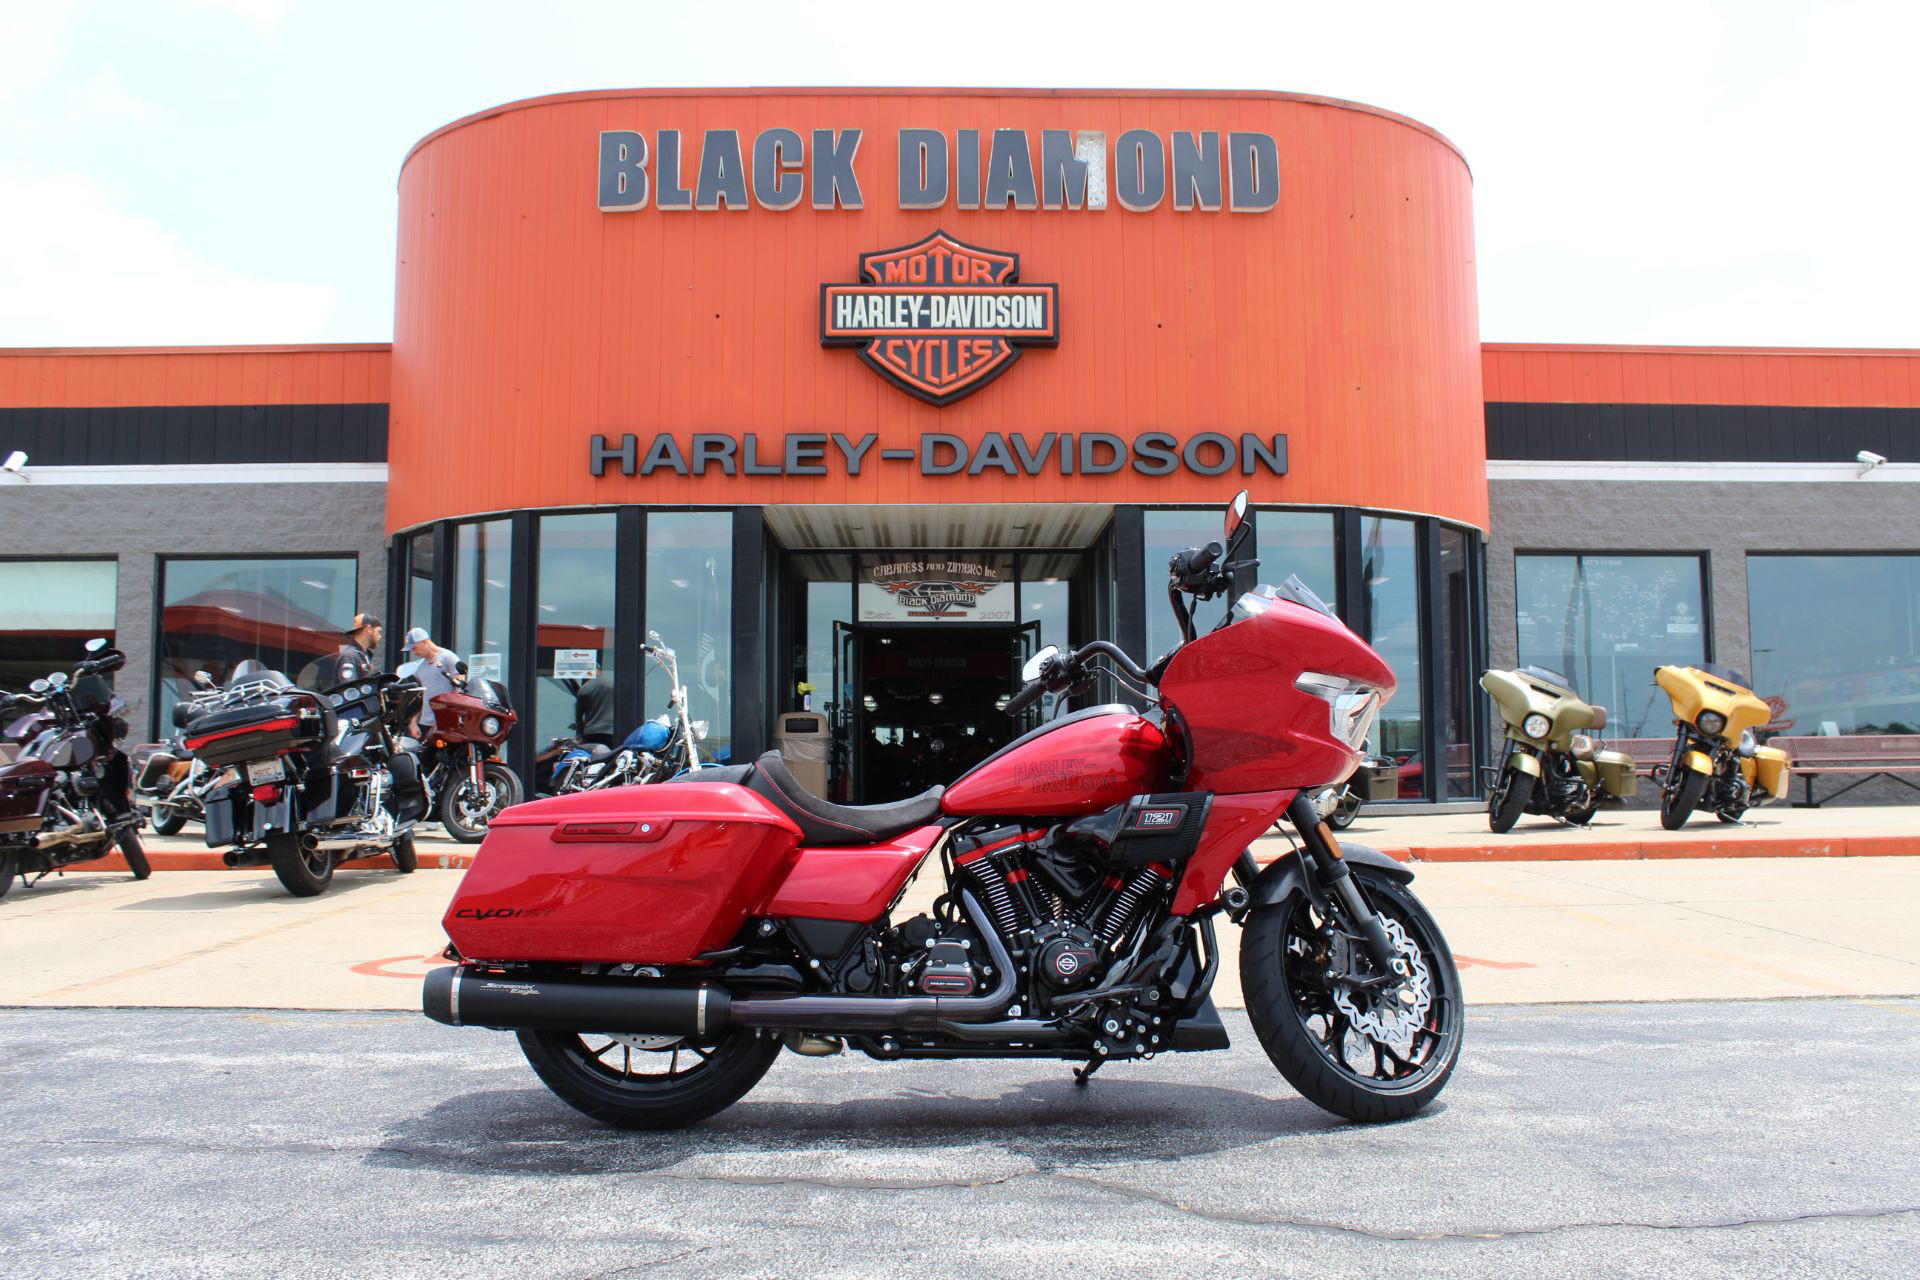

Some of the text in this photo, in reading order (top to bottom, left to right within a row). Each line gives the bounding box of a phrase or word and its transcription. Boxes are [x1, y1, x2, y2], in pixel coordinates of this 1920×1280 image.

[598, 128, 1280, 212] BLACK DIAMOND
[884, 246, 992, 285] MOTOR
[837, 294, 1043, 329] HARLEY-DAVIDSON
[888, 338, 995, 386] CYCLES
[589, 432, 1289, 477] HARLEY-DAVIDSON
[979, 610, 1011, 620] 2007
[1144, 812, 1174, 823] 121
